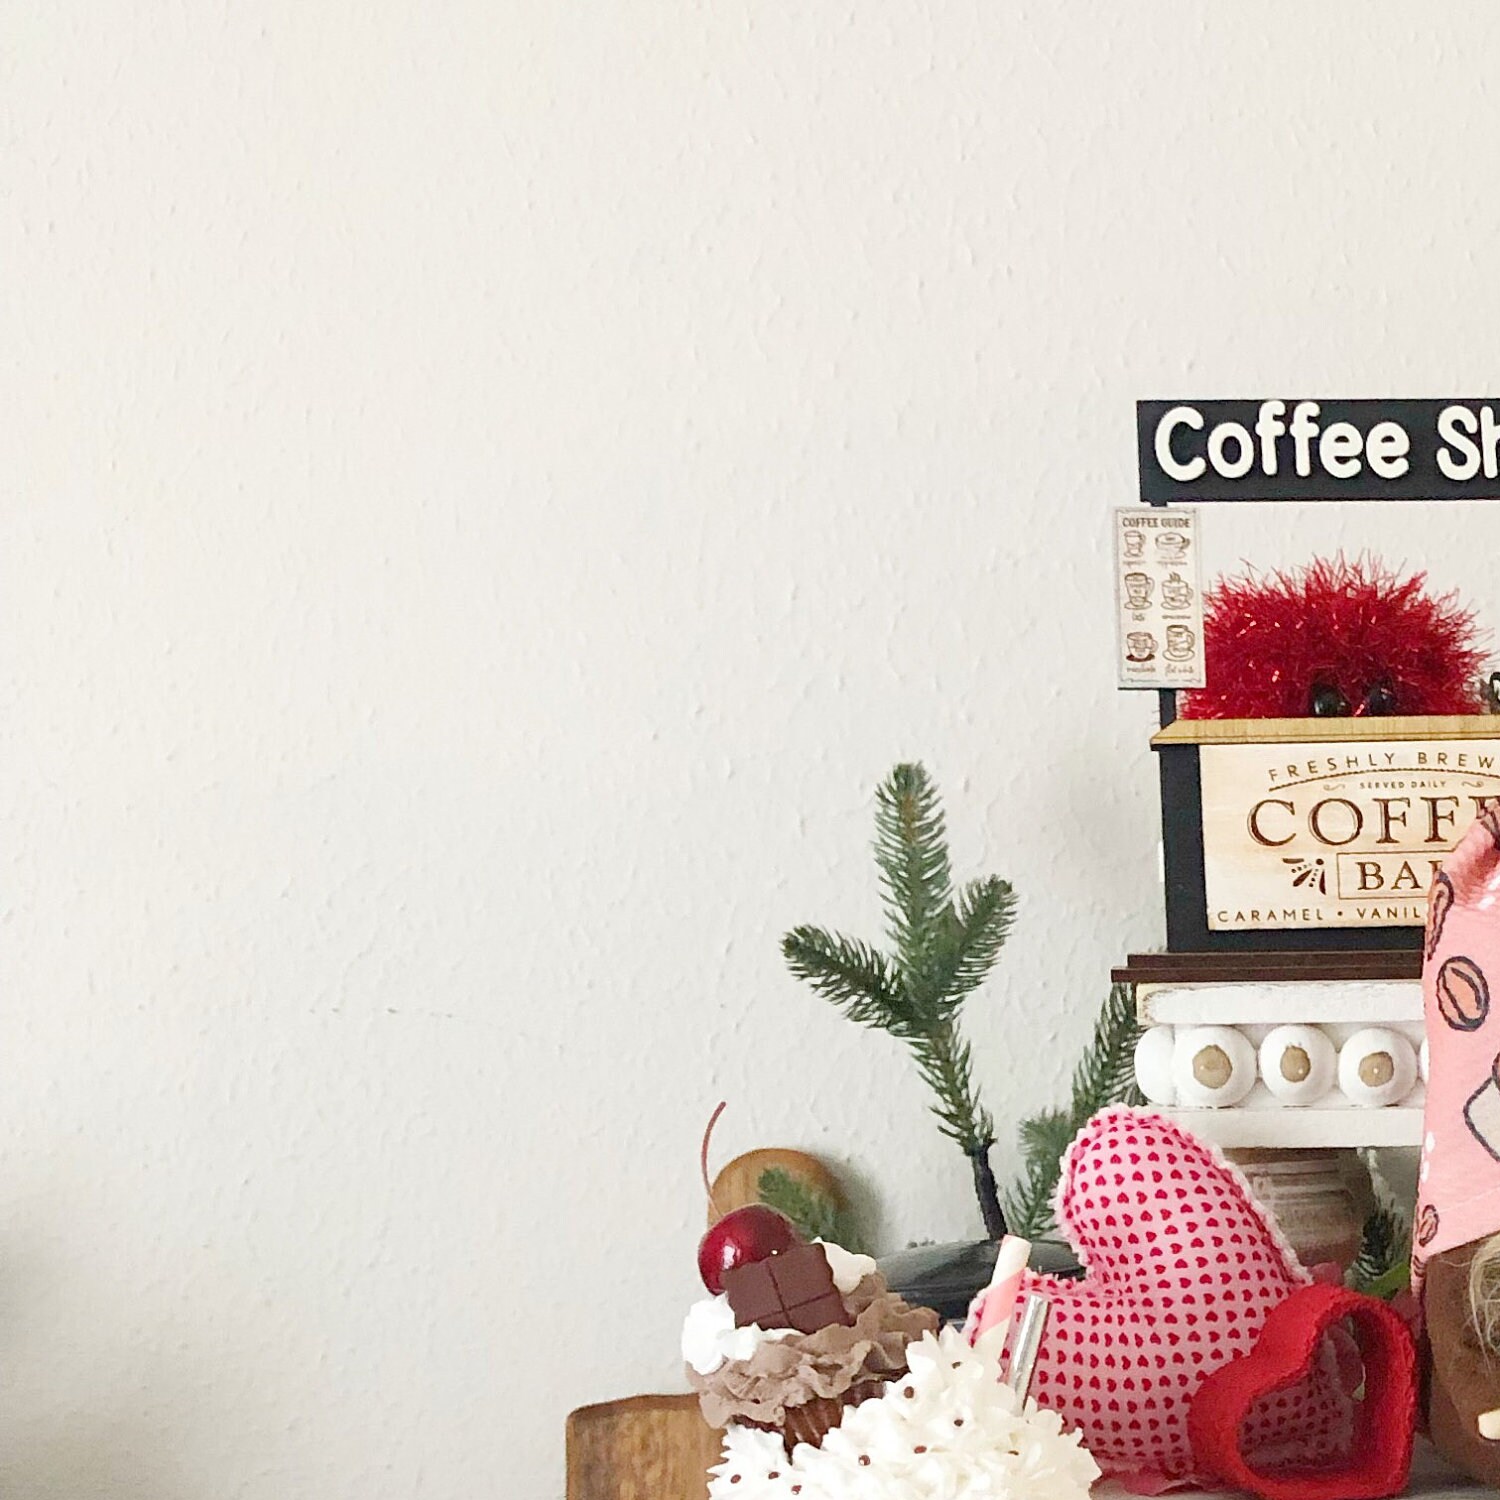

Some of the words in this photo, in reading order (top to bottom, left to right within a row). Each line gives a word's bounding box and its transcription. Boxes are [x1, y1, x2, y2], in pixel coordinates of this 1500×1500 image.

[1154, 400, 1411, 482] Coffee
[1122, 517, 1158, 528] COFFEE
[1161, 517, 1190, 528] GUIDE
[1268, 751, 1396, 780] FRESHLY
[1360, 781, 1405, 789] SERVED
[1356, 860, 1442, 891] BA
[1217, 909, 1324, 923] CARAMEL
[1357, 907, 1421, 920] VANIL
